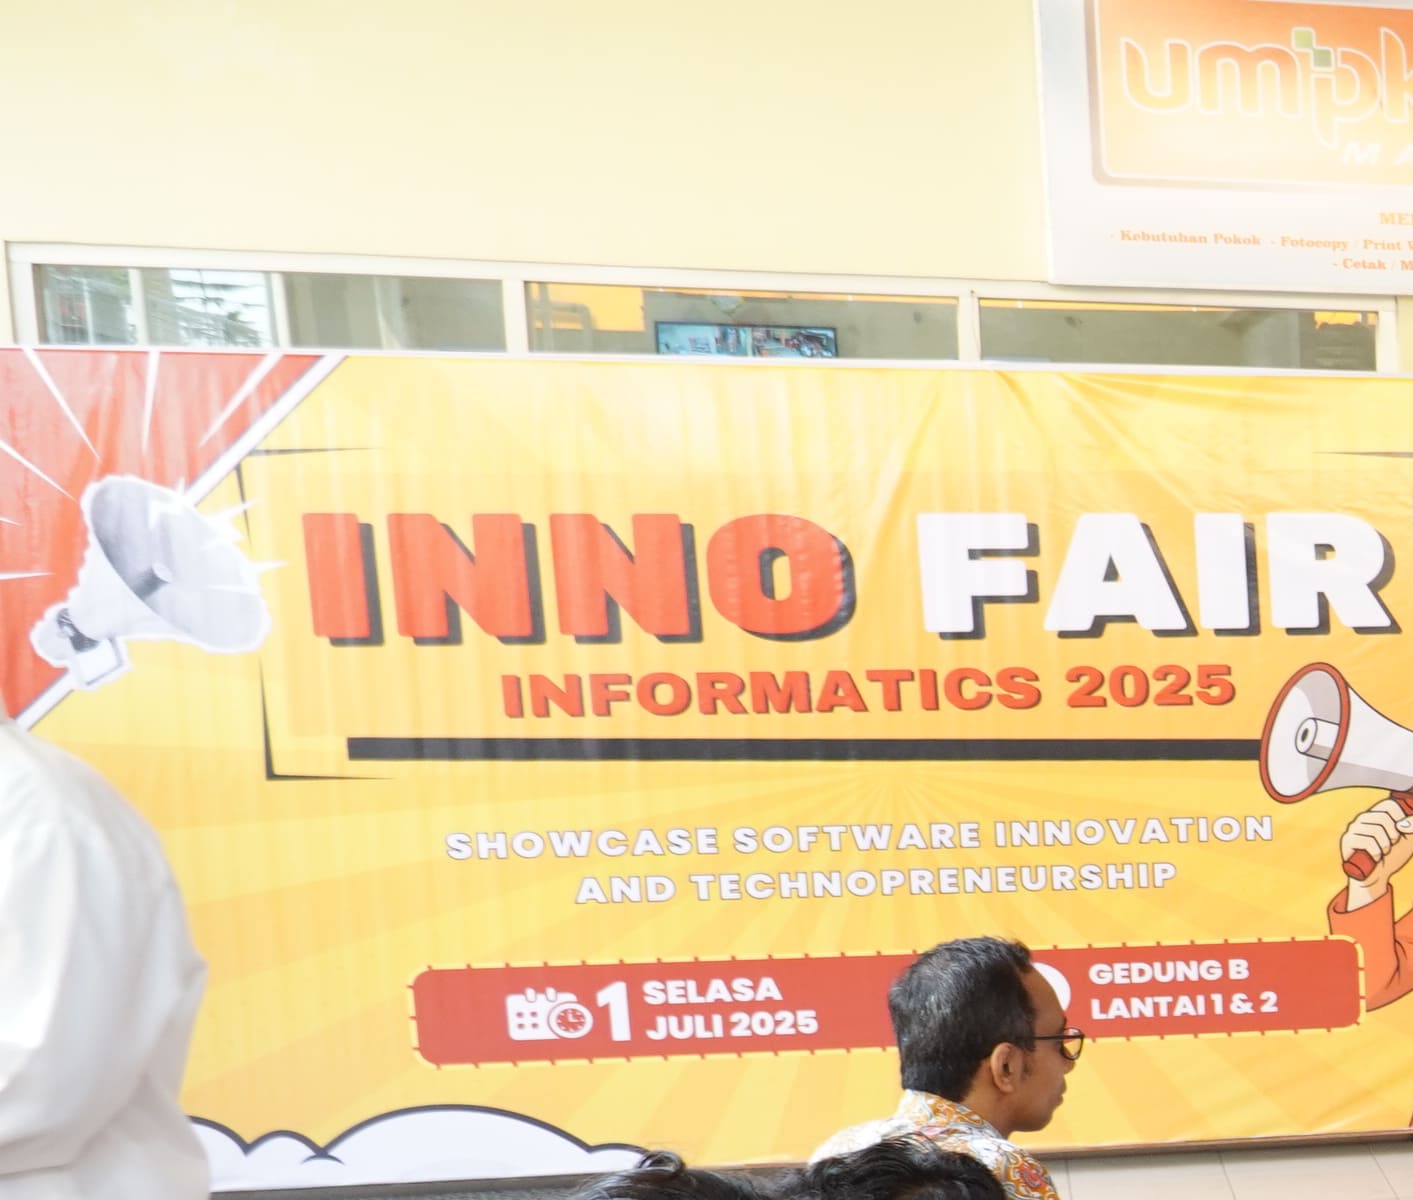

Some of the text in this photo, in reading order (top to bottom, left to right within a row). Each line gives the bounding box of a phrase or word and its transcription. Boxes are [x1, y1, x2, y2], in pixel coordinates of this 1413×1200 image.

[1120, 229, 1207, 245] Kebutuhan
[1213, 232, 1262, 246] Pokok
[1280, 235, 1348, 252] Fotocopy
[1362, 239, 1404, 252] Print
[1342, 258, 1387, 271] Cetak
[301, 510, 1403, 647] INNO FAIR
[500, 663, 1236, 719] INFORMATICS 2025
[445, 815, 1274, 860] SHOWCASE SOFTWARE INNOVATION
[575, 861, 1178, 905] AND TECHNOPRENEURSHIP
[1088, 959, 1250, 985] GEDUNG B
[642, 976, 784, 1005] SELASA
[1090, 991, 1279, 1021] LANTAI 1 & 2
[595, 980, 632, 1042] 1
[645, 1009, 819, 1042] JULI 2025
